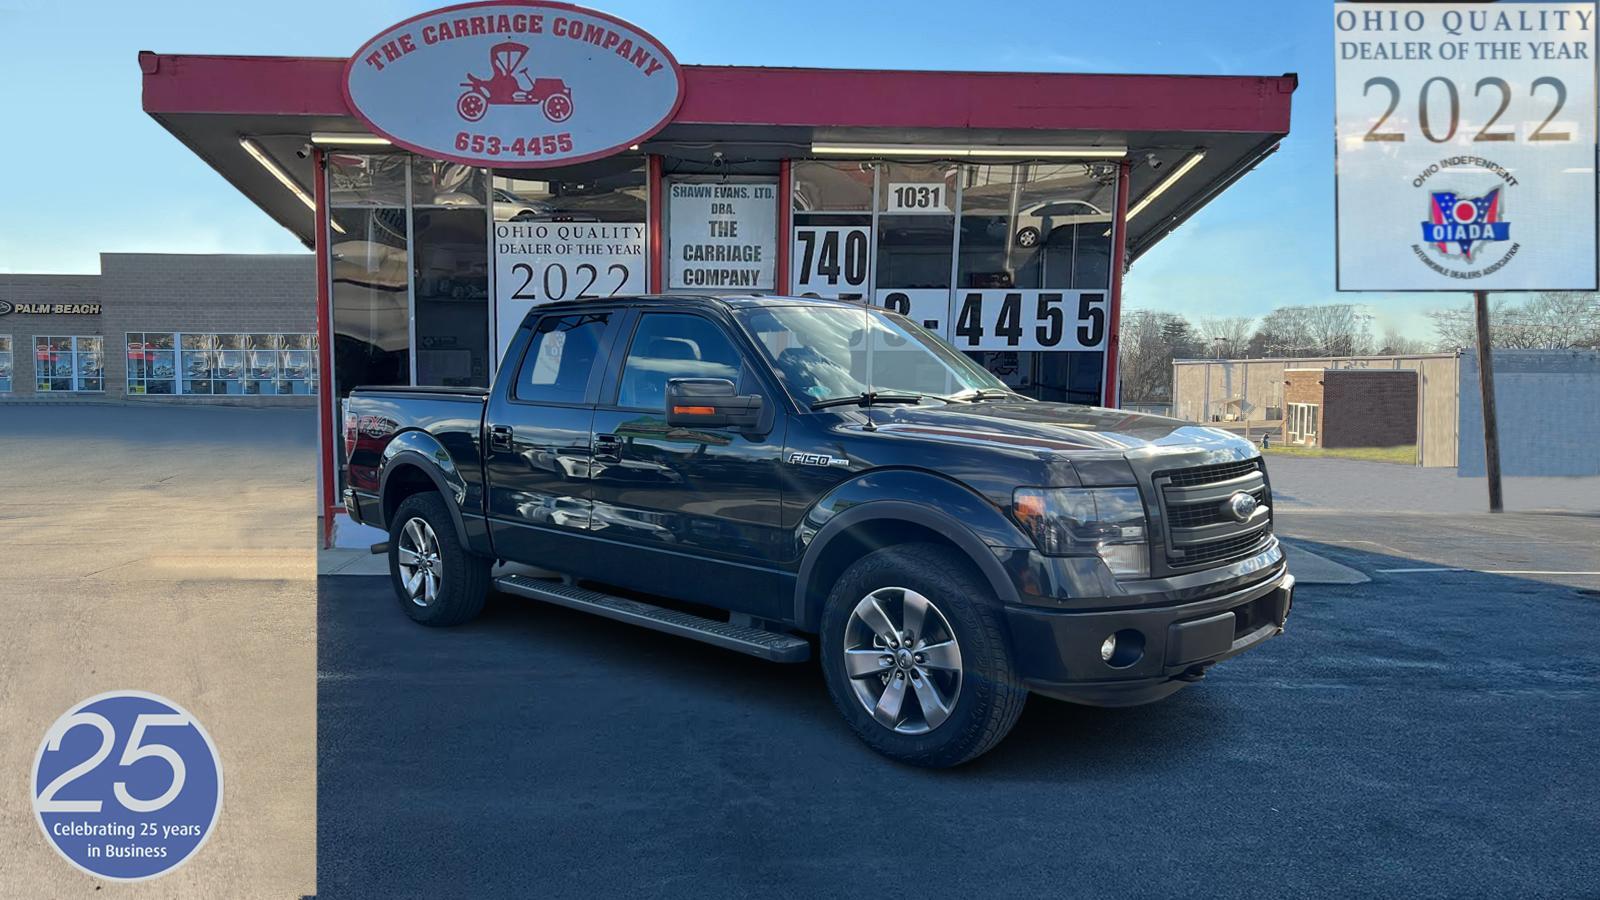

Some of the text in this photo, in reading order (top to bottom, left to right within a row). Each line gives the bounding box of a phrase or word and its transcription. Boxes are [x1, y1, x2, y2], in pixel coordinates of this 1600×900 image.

[1336, 10, 1592, 36] OHIO QUALITY
[365, 14, 663, 76] THE CARRIAGE COMPANY
[1340, 42, 1588, 60] DEALER OF THE YEAR
[1363, 76, 1570, 143] 2022
[455, 131, 573, 156] 653-4455
[1412, 156, 1519, 188] OHIO INDEPENDENT
[673, 186, 711, 198] SHAWN
[754, 187, 774, 199] LTD.
[894, 187, 940, 208] 1031
[711, 203, 736, 215] DBA.
[497, 226, 644, 240] OHIO QUALITY
[708, 221, 738, 237] THE
[1432, 225, 1495, 240] OIADA
[500, 244, 642, 255] DEALER OF THE YEAR
[683, 244, 762, 262] CARRIAGE
[797, 230, 868, 286] 740
[1411, 244, 1449, 277] AUTOMOBILE
[1482, 242, 1521, 276] ASSOCIATION
[511, 263, 629, 300] 2022
[683, 268, 761, 286] COMPANY
[14, 303, 100, 314] PALM BEACH
